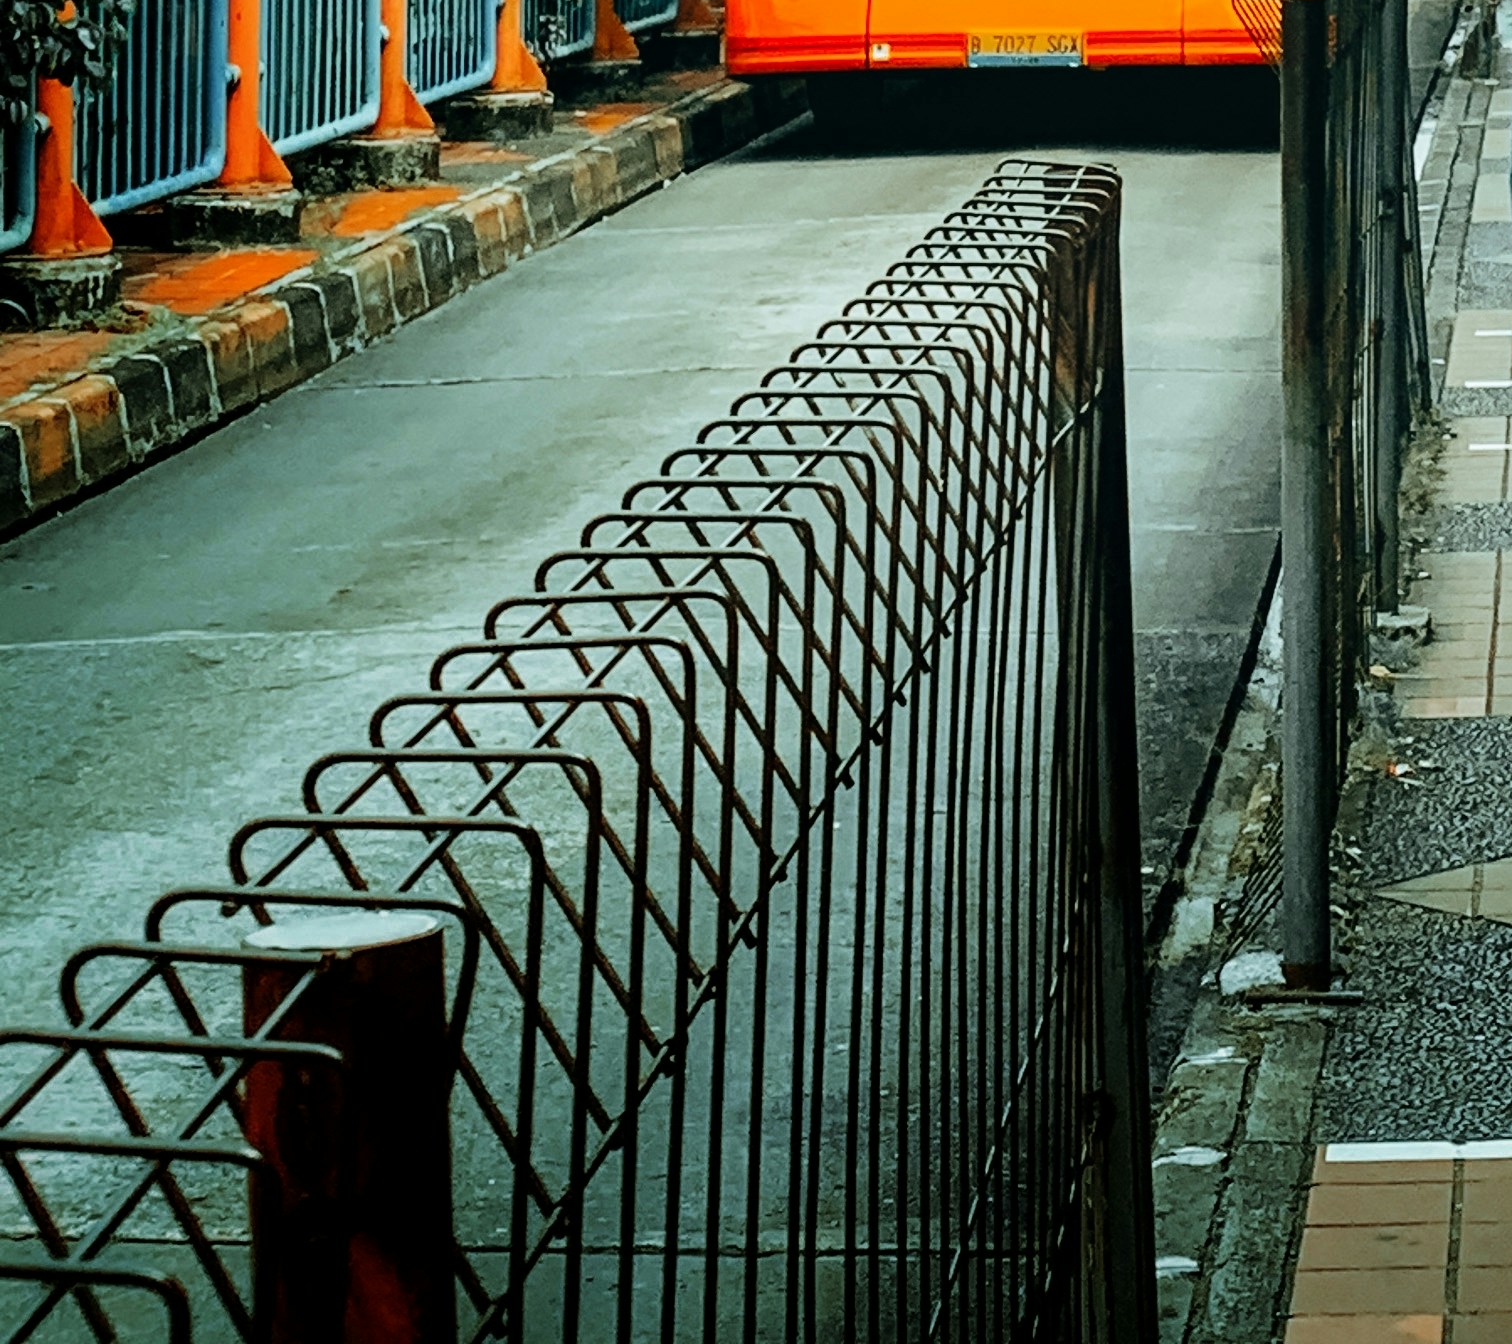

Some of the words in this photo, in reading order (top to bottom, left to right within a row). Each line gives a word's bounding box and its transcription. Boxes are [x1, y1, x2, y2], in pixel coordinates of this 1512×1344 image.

[970, 35, 982, 55] B
[993, 35, 1037, 55] 7027
[1046, 34, 1079, 55] SGX
